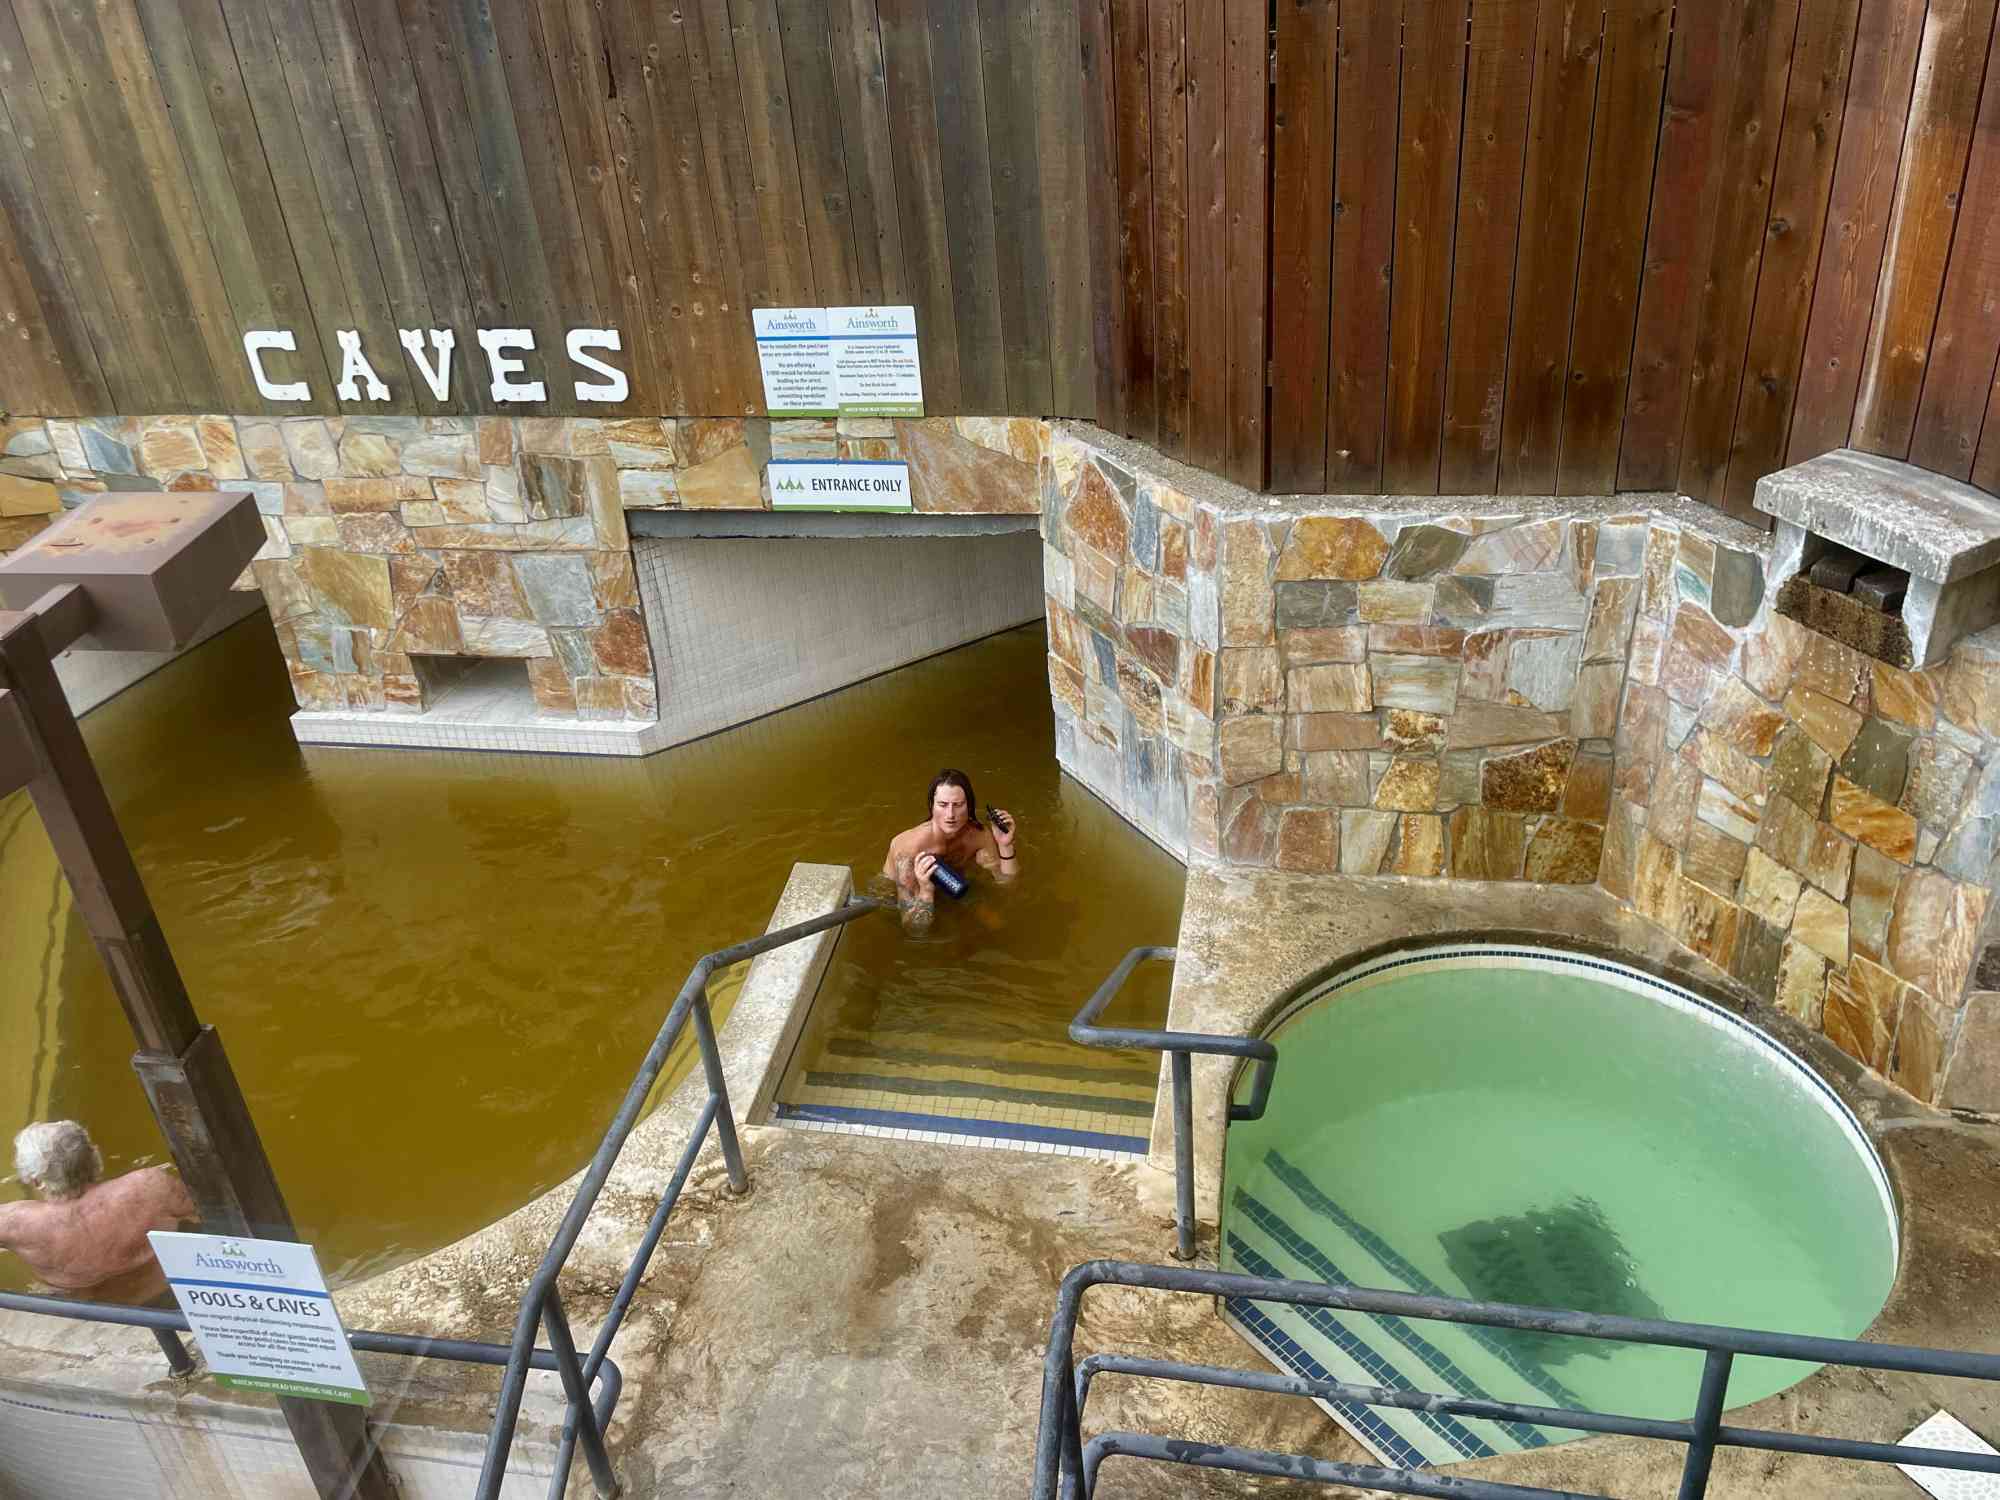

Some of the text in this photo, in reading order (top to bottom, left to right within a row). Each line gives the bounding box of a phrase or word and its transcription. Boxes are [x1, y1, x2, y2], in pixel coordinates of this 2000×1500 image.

[767, 318, 816, 330] Ainsworth
[847, 316, 898, 329] Ainsworth
[243, 328, 629, 402] CAVES
[812, 478, 902, 492] ENTRANCE ONLY
[196, 1252, 284, 1274] Ainsworth
[188, 1290, 321, 1317] POOLS & CAVES
